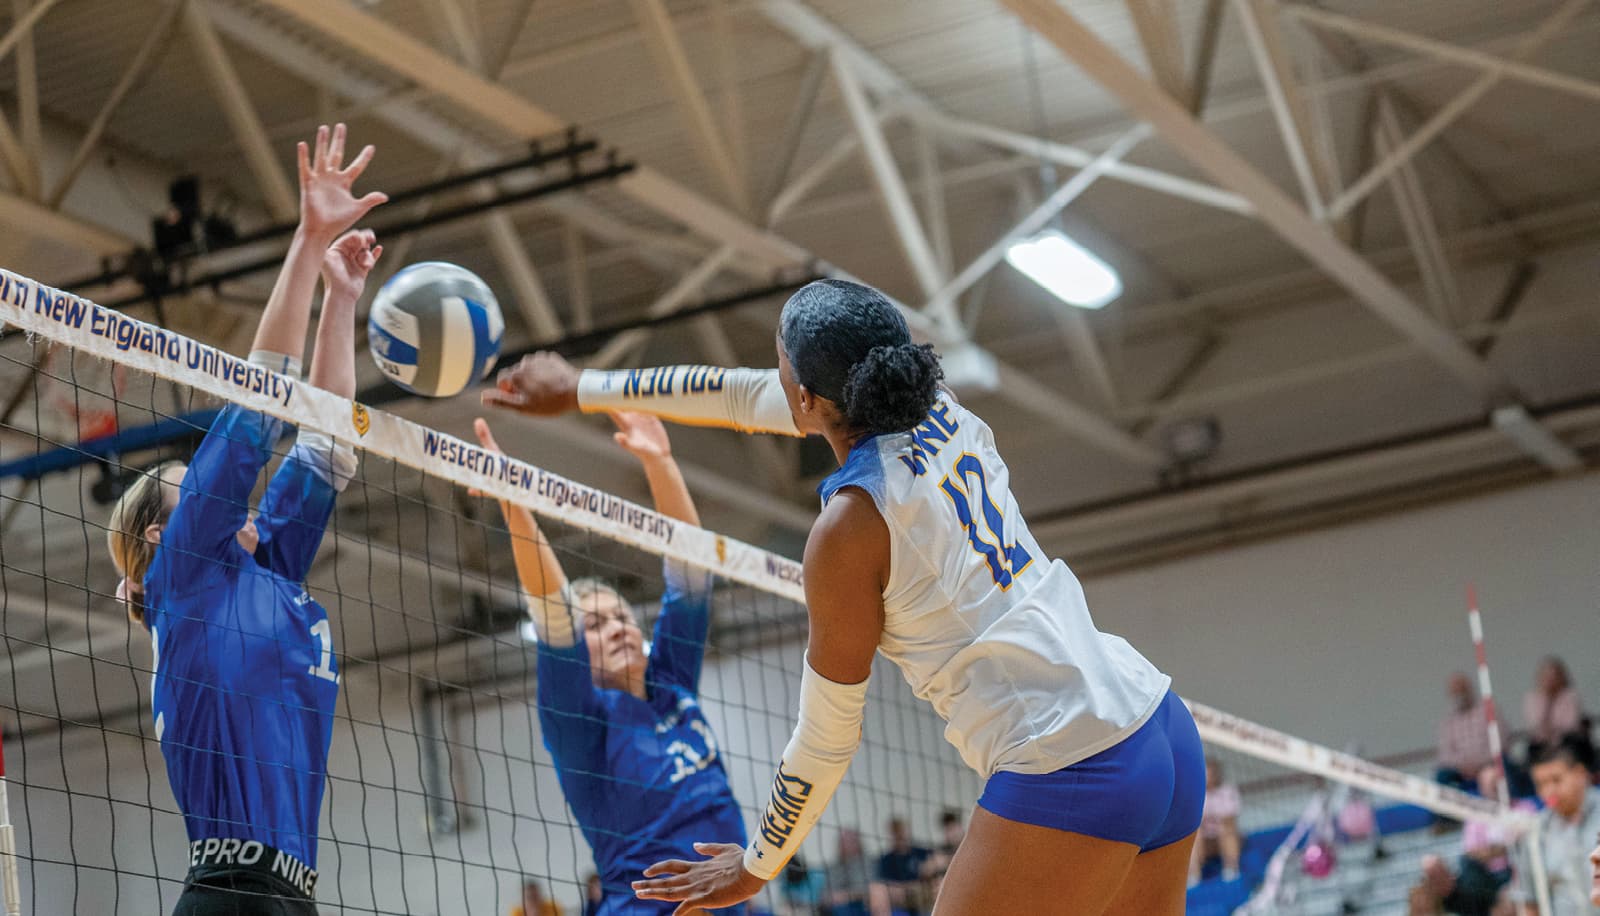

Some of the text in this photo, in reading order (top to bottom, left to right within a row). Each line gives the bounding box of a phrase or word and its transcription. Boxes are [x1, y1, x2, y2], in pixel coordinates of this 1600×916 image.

[35, 286, 87, 328] New
[91, 304, 180, 363] England
[186, 340, 293, 406] University
[423, 427, 675, 544] Western New England University
[938, 450, 1034, 592] 12
[308, 619, 340, 684] 1
[761, 759, 813, 849] BEARS
[190, 838, 318, 898] EPRO NIKE
